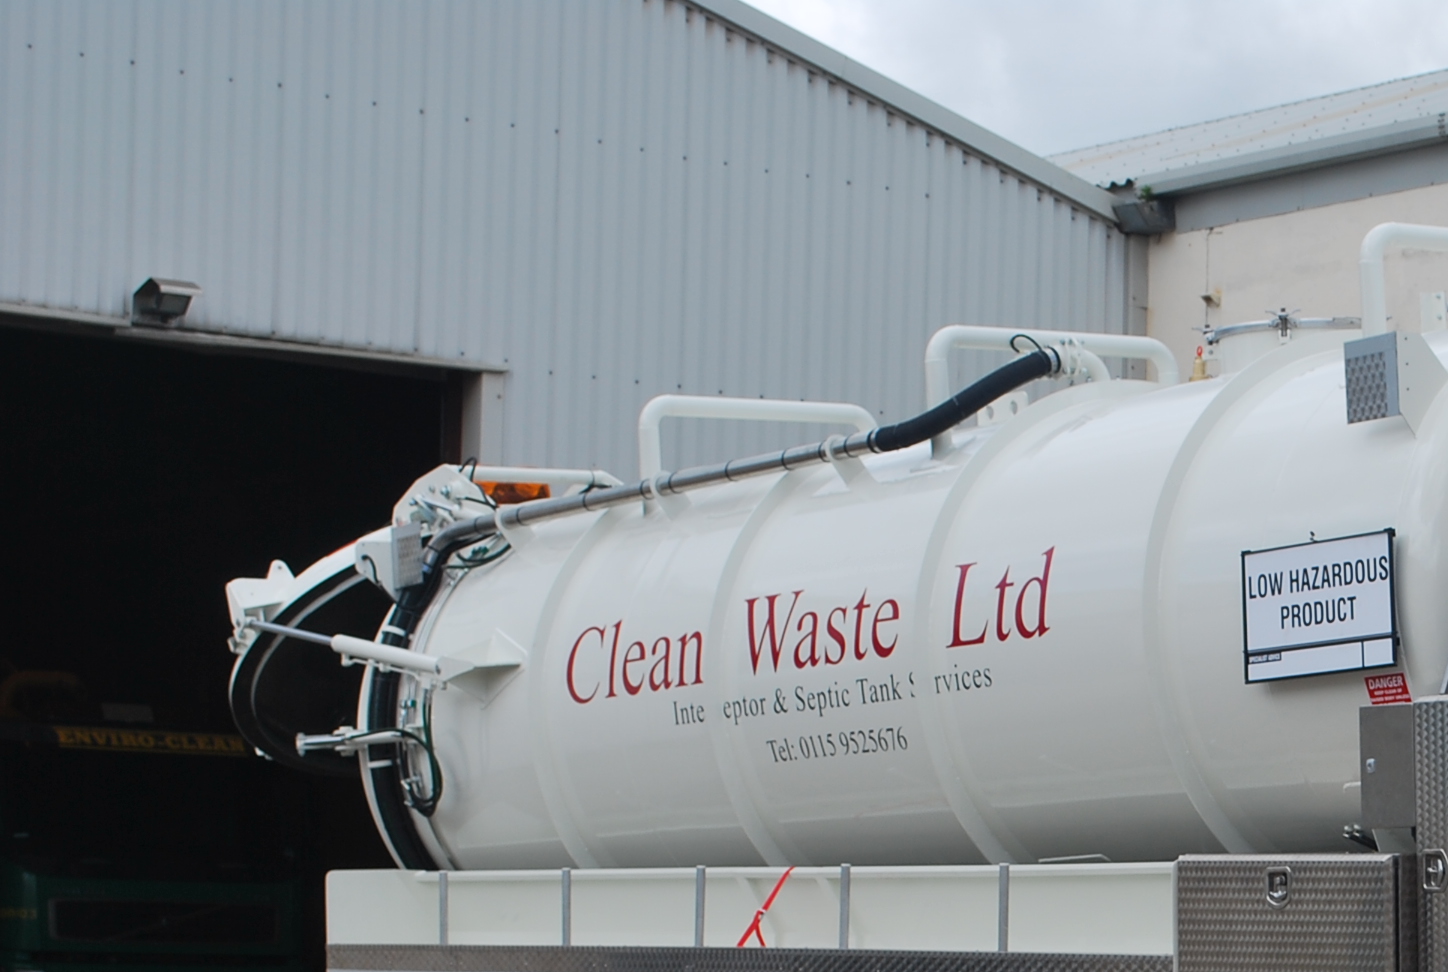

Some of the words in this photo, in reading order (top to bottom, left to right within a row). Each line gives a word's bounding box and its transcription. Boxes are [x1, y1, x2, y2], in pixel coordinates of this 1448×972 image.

[1248, 571, 1284, 600] LOW
[1289, 555, 1389, 594] HAZARDOUS
[566, 620, 704, 704] Clean
[746, 588, 901, 676] Waste
[946, 546, 1055, 649] Ltd
[1280, 595, 1357, 630] PRODUCT
[673, 697, 767, 726] Inteeptor
[773, 688, 788, 714] &
[794, 681, 851, 717] Septic
[856, 674, 903, 705] Tank
[1368, 676, 1404, 690] DANGER
[766, 737, 798, 763] Tel:
[799, 732, 837, 760] 0115
[838, 726, 908, 756] 9525676
